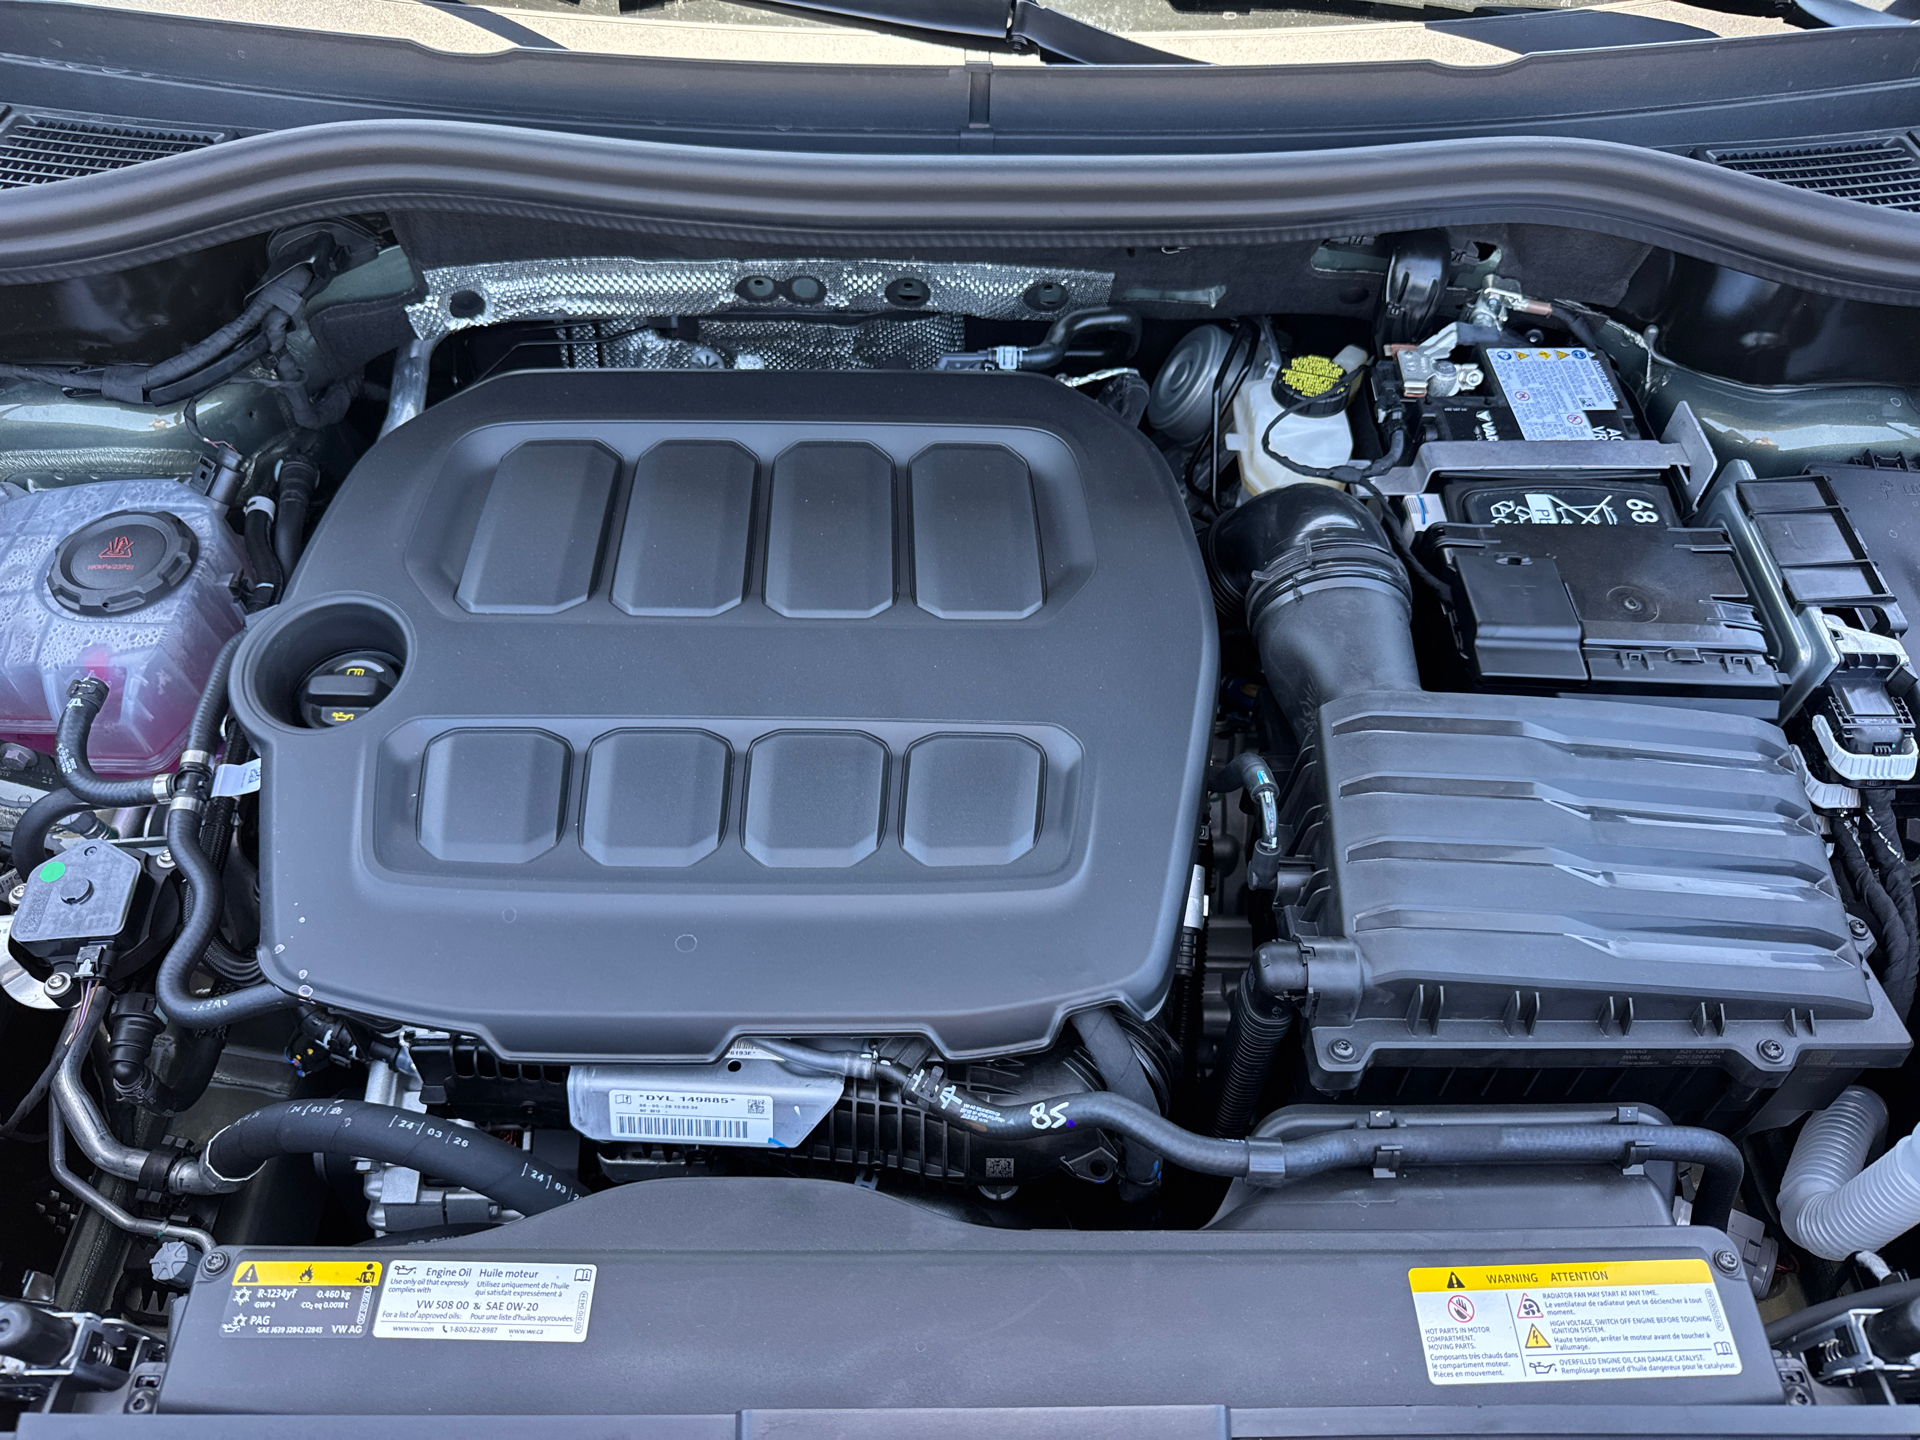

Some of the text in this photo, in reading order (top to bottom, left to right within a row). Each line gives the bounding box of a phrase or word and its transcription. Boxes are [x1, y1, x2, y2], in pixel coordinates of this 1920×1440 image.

[426, 1267, 472, 1278] Engine Oil
[479, 1268, 539, 1278] Huile moteur
[1486, 1270, 1609, 1284] WARNING ATTENTION
[403, 1278, 417, 1286] only
[440, 1279, 470, 1288] expressly
[502, 1282, 540, 1290] uniquement
[550, 1282, 570, 1290] l'huile
[388, 1286, 416, 1294] complies
[512, 1290, 557, 1298] expressément
[340, 1290, 352, 1300] kg
[416, 1300, 539, 1311] VW 508 00 & SAE 0W-20
[1553, 1300, 1587, 1308] ventilateur
[1650, 1297, 1682, 1305] déclencher
[382, 1310, 393, 1318] For
[418, 1312, 448, 1320] approved
[512, 1314, 536, 1322] d'huiles
[1656, 1316, 1680, 1324] BEFORE
[1680, 1315, 1712, 1323] TOUCHING
[250, 1316, 270, 1325] PAG
[331, 1325, 363, 1334] VW AG
[1426, 1334, 1475, 1343] COMPARTMENT.
[1430, 1353, 1468, 1362] Composants
[1558, 1357, 1597, 1366] OVERFILLED
[1622, 1356, 1633, 1364] OIL
[1674, 1354, 1706, 1362] CATALYST.
[1439, 1361, 1484, 1370] compartiment
[1561, 1367, 1600, 1375] Remplissage
[1601, 1365, 1626, 1373] excessif
[1648, 1364, 1680, 1373] dangereux
[1704, 1362, 1737, 1370] catalyseur.
[1433, 1370, 1454, 1378] Pièces
